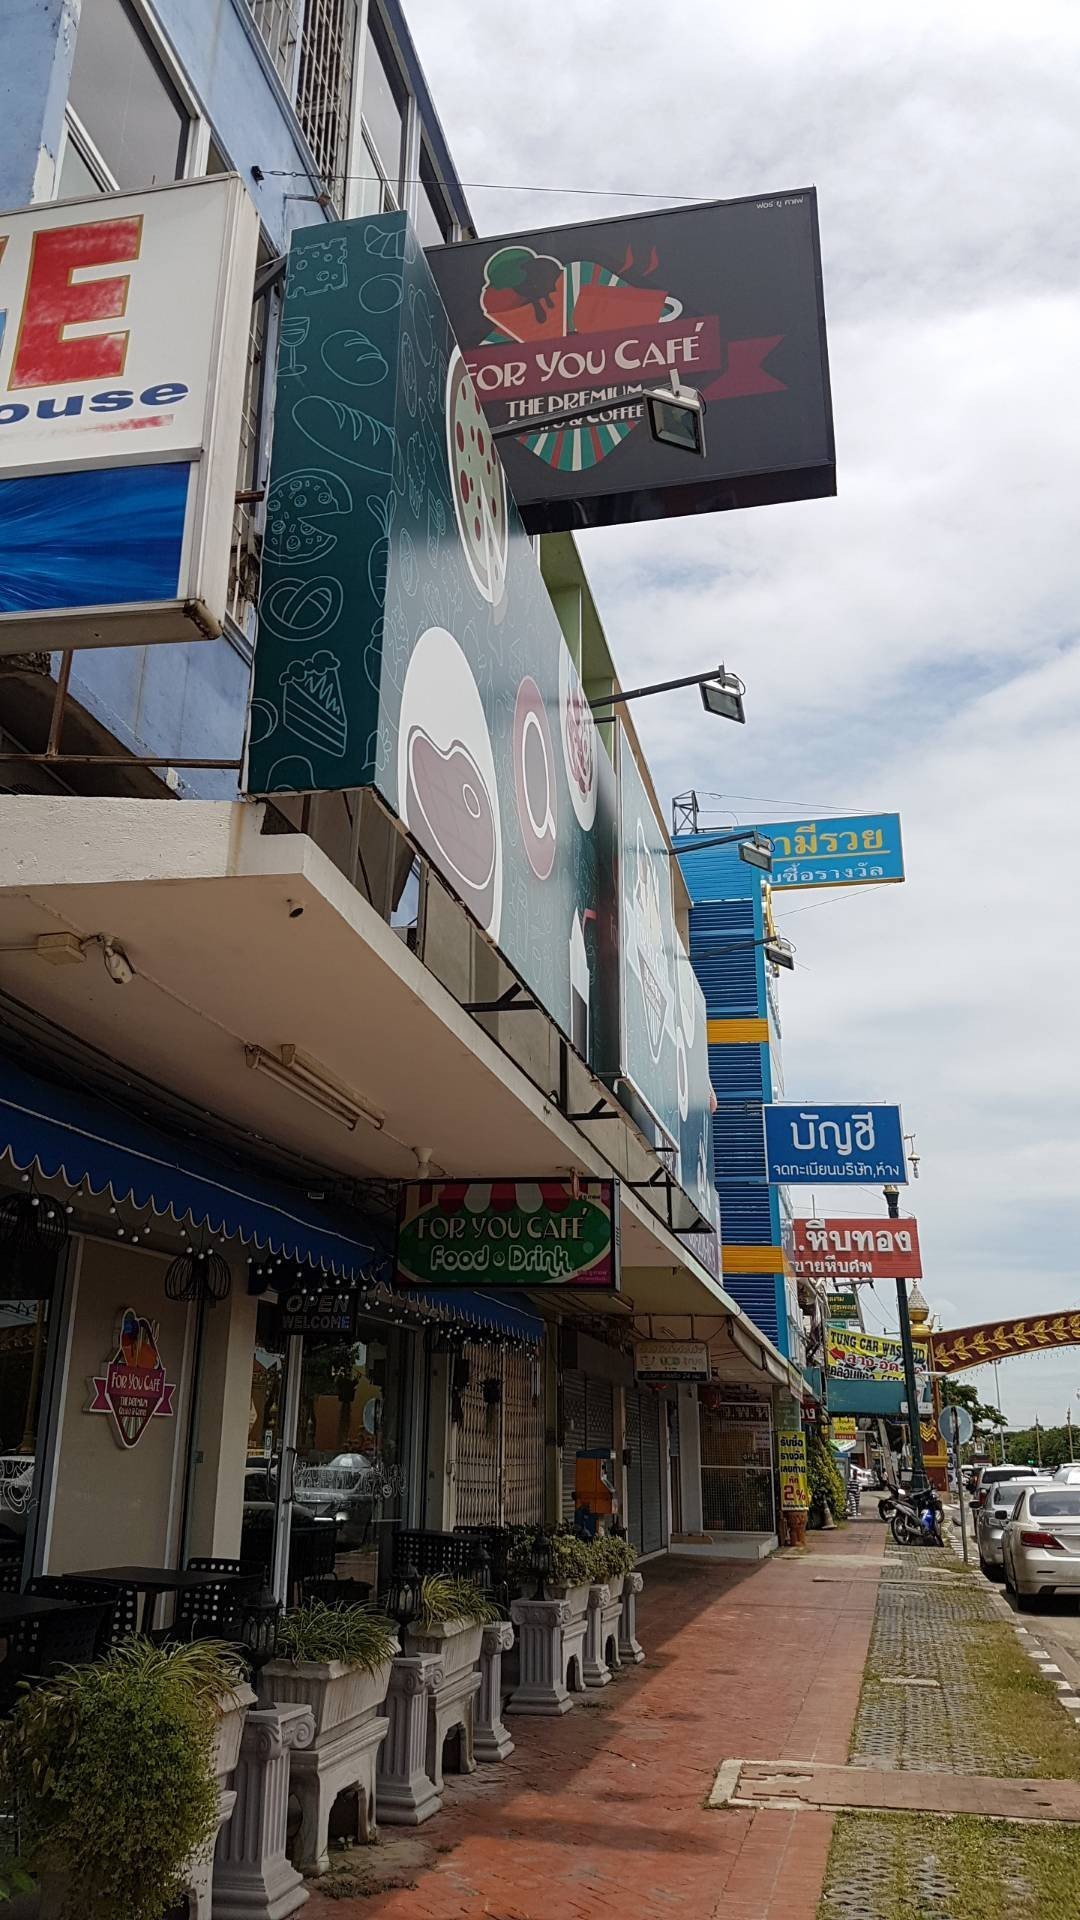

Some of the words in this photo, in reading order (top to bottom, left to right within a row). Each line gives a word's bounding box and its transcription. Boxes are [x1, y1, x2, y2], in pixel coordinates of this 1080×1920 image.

[0, 214, 144, 391] E
[535, 348, 606, 383] YOU
[614, 321, 705, 370] CAFÉ
[505, 397, 545, 418] THE
[773, 823, 883, 856] ามีรวย
[763, 862, 884, 884] บซื้อรางวัล
[790, 1111, 876, 1156] บัญชี
[417, 1216, 465, 1240] FOR
[471, 1216, 522, 1240] YOU
[526, 1207, 588, 1240] CAFÉ
[792, 1218, 913, 1252] .หีบทอง
[508, 1243, 573, 1278] Drink
[286, 1295, 350, 1312] OPEN
[282, 1314, 351, 1329] WELCOME
[830, 1331, 857, 1348] TUNG
[859, 1338, 879, 1352] CAR
[882, 1343, 903, 1358] WAS
[111, 1371, 127, 1389] FOR
[128, 1373, 143, 1391] YOU
